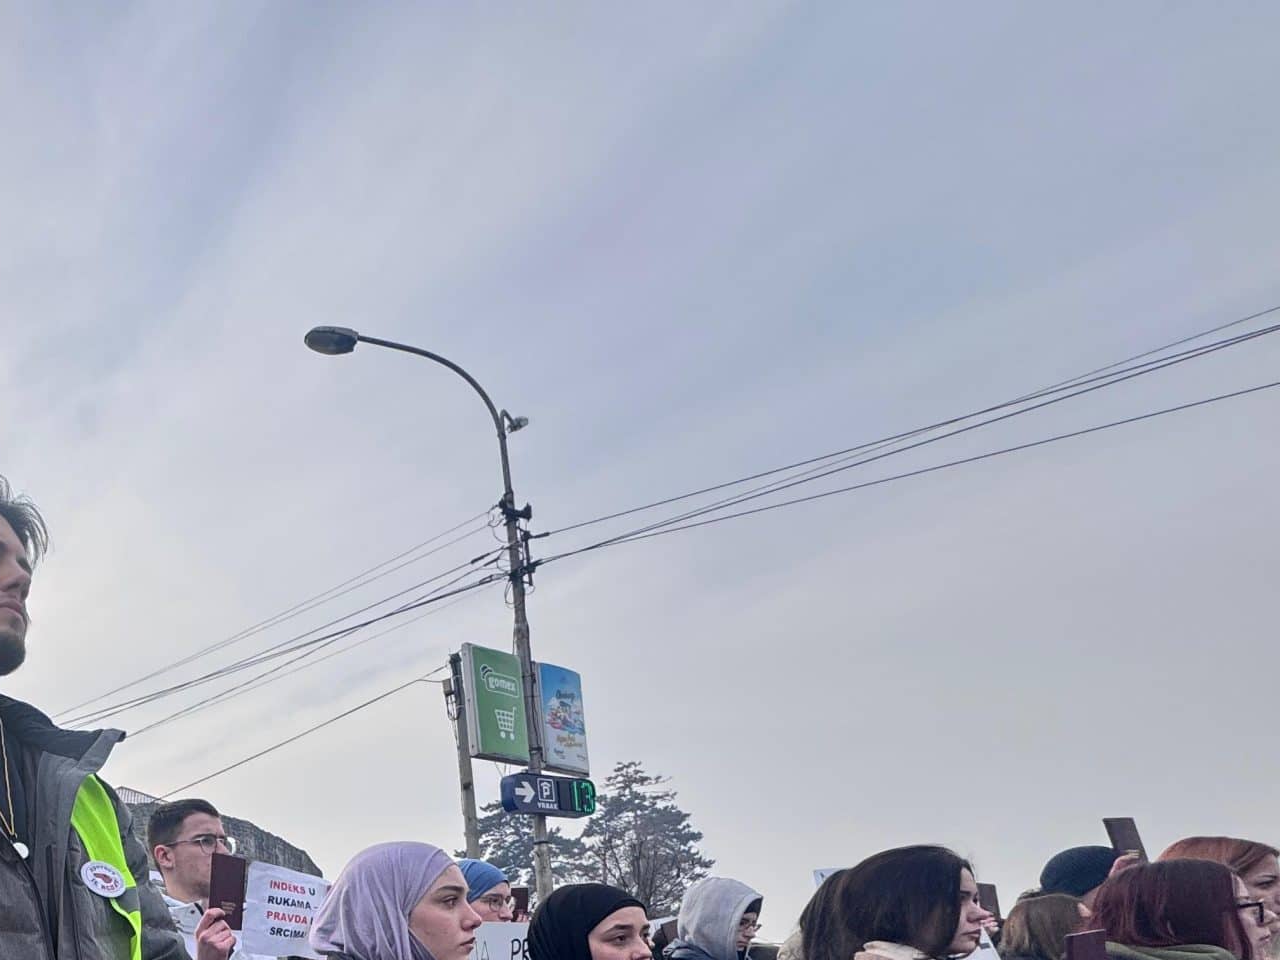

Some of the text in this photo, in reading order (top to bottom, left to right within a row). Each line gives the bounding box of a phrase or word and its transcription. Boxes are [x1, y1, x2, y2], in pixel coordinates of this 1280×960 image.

[488, 676, 516, 692] gomex
[270, 879, 316, 896] INDEKS U
[267, 895, 312, 910] RUKAMA
[266, 910, 308, 925] PRAVDA
